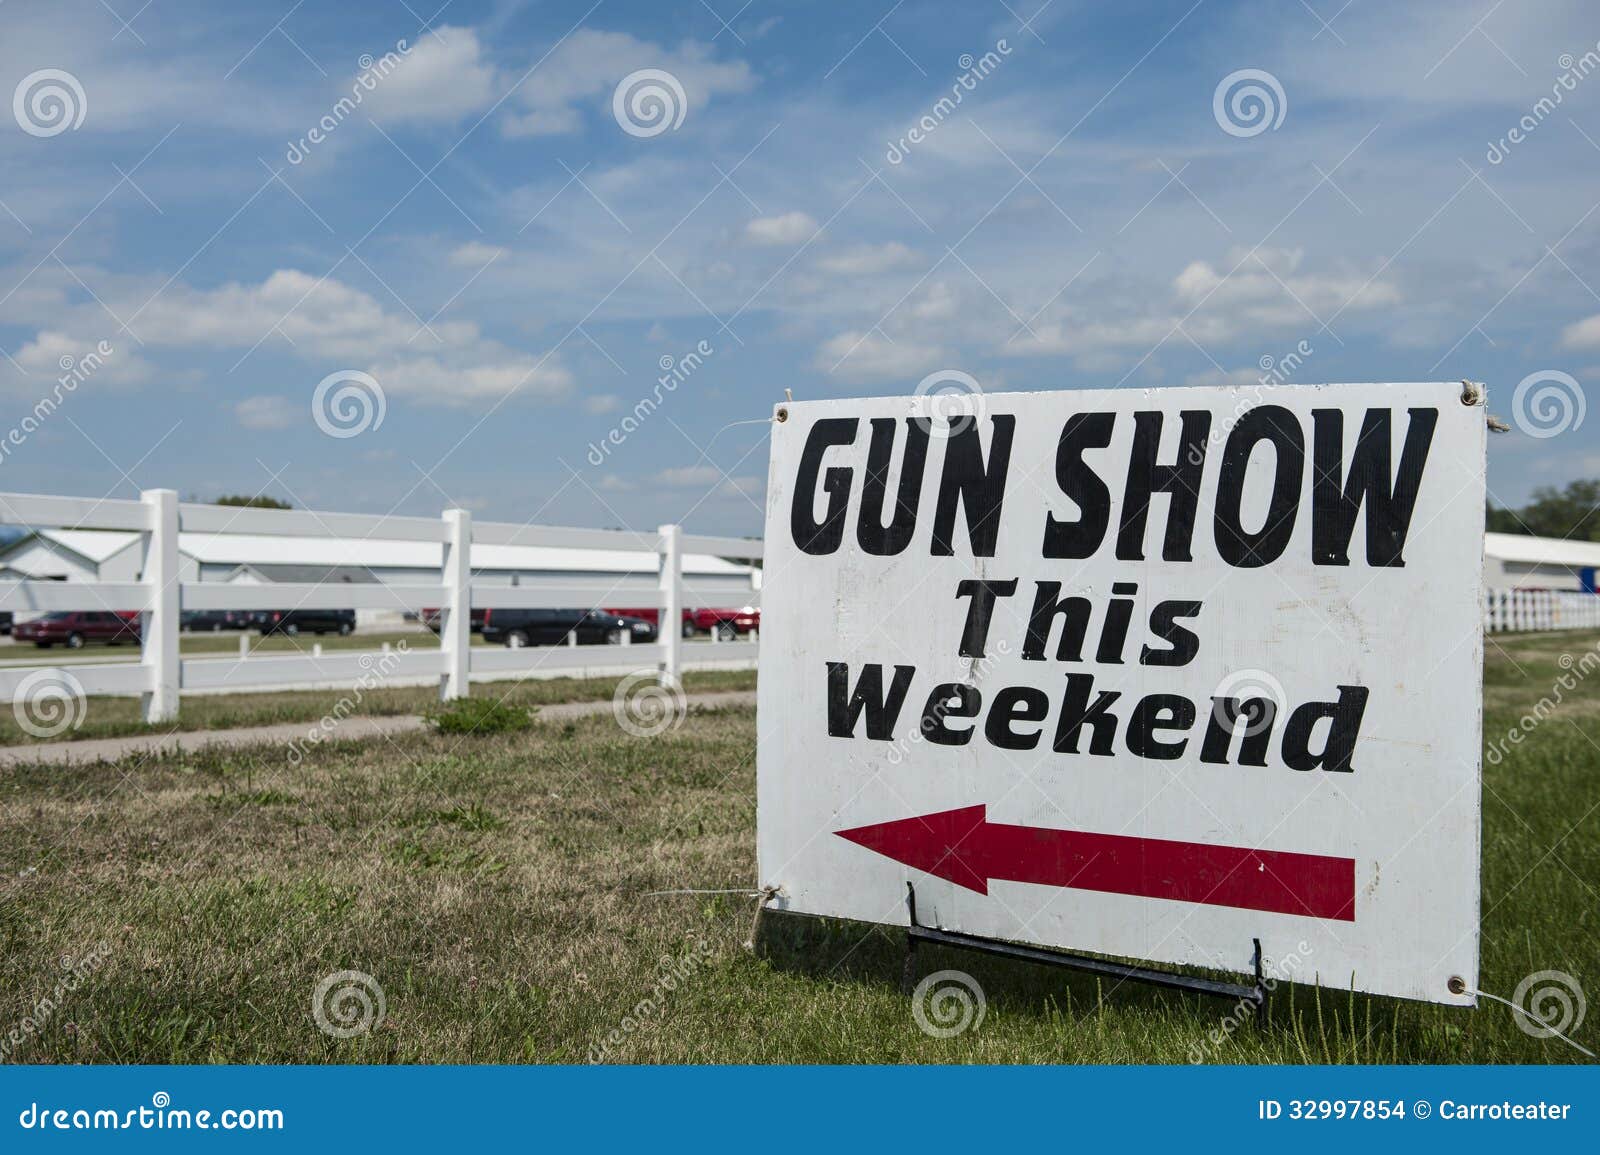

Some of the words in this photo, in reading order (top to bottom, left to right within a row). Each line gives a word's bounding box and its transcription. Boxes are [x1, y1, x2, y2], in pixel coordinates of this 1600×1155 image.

[790, 414, 1016, 558] GUN
[1042, 404, 1439, 569] SHOW
[955, 577, 1203, 667] This
[825, 661, 1370, 774] Weekend
